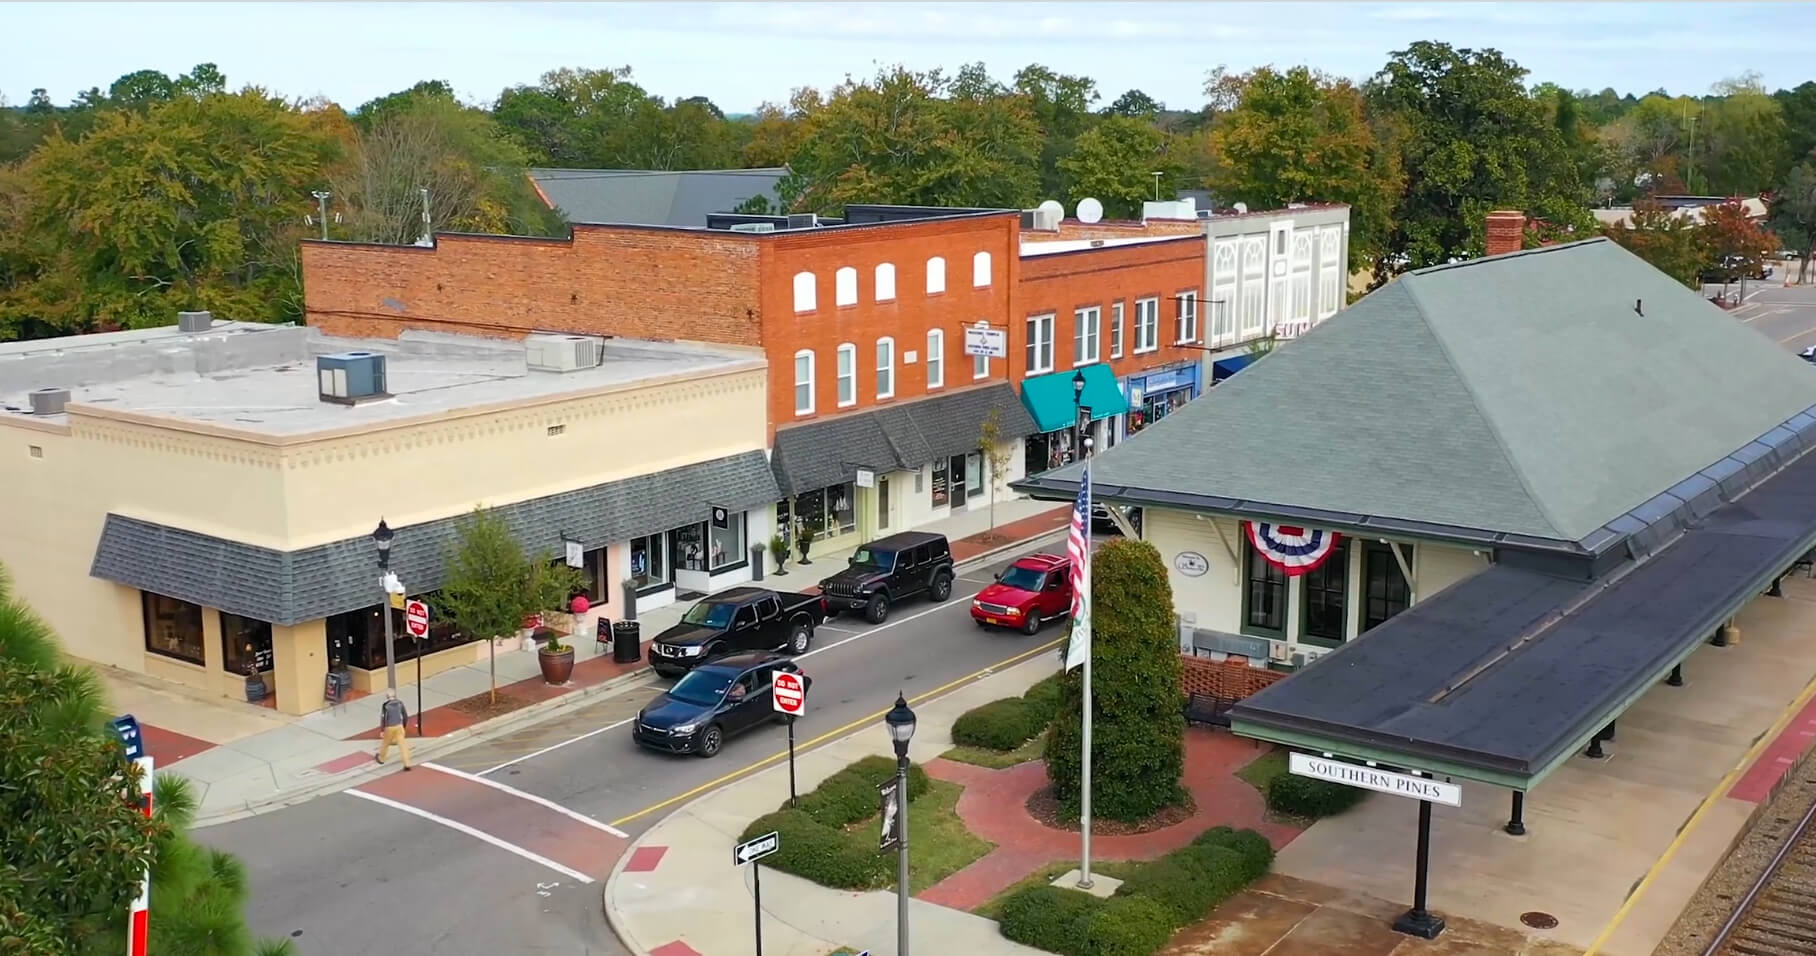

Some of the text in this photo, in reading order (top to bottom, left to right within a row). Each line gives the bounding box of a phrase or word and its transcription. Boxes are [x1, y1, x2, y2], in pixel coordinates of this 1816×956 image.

[411, 622, 425, 631] ENTER
[777, 679, 799, 690] DO NOT
[780, 696, 798, 706] ENTER
[1308, 760, 1441, 798] SOUTHERN PINES
